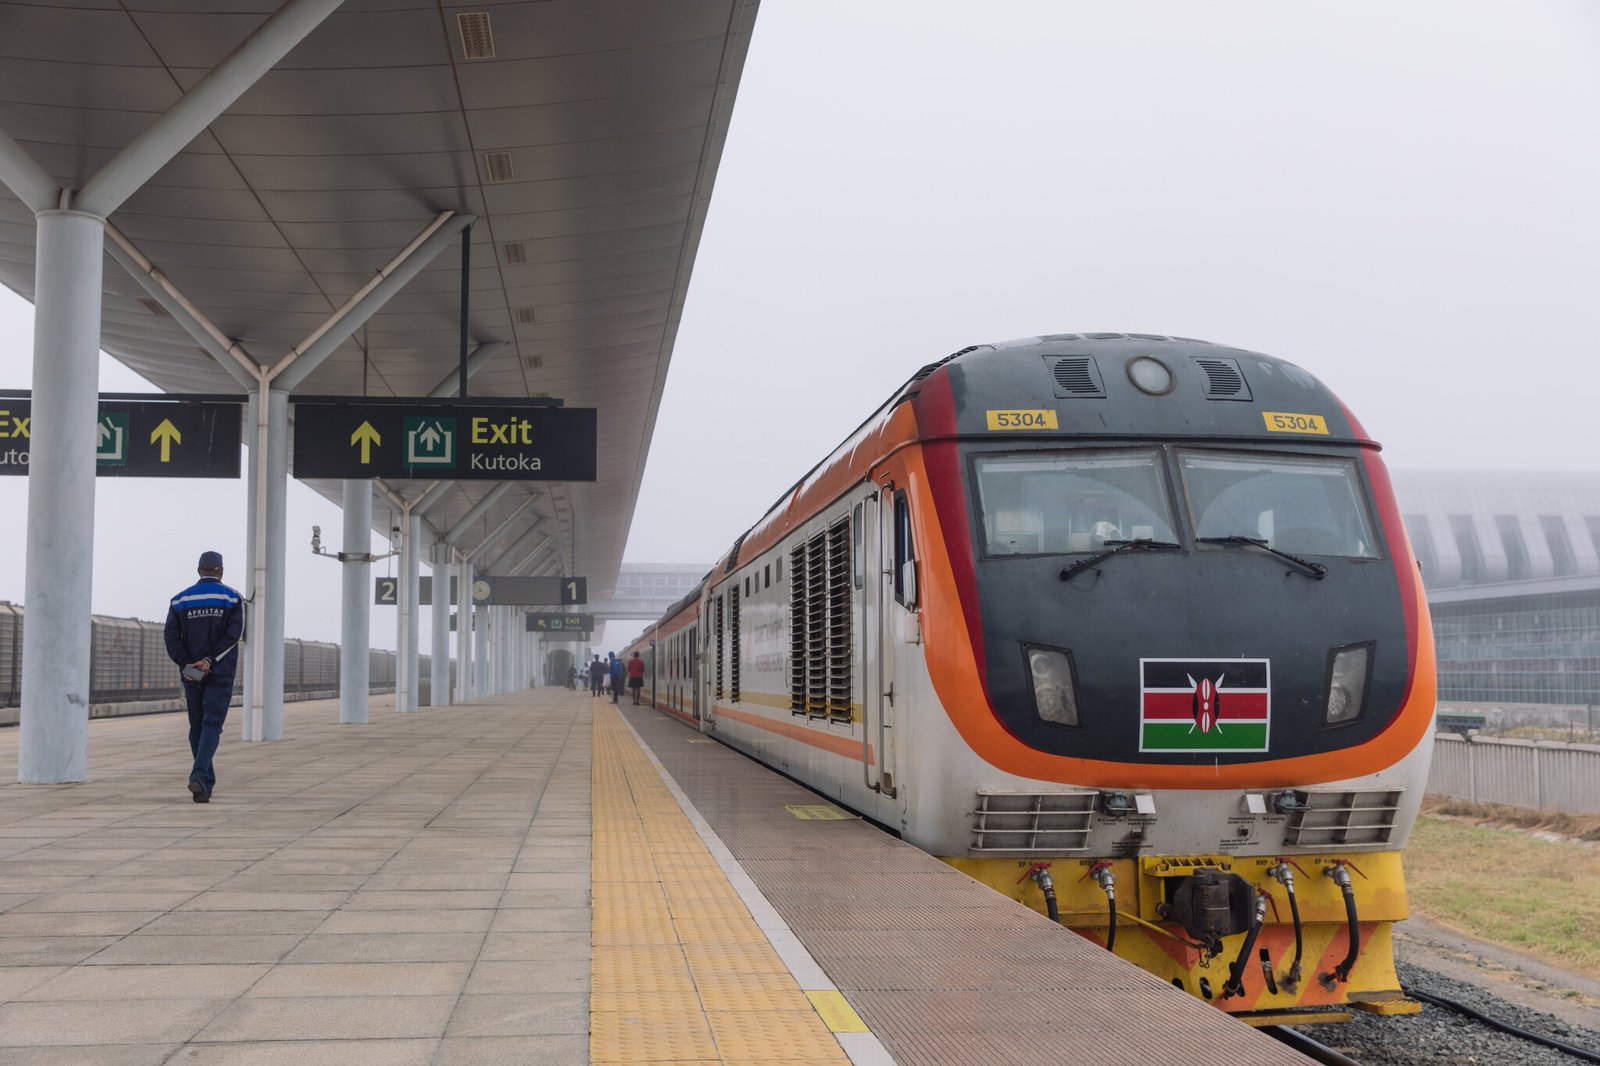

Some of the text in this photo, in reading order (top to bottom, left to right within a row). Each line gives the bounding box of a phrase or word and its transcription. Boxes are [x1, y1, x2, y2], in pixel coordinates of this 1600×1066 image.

[0, 410, 31, 438] Ex
[997, 413, 1047, 428] 5304
[1273, 415, 1320, 432] 5304
[471, 416, 533, 445] Exit
[0, 449, 31, 465] uto
[471, 453, 542, 471] Kutoka
[381, 581, 395, 601] 2
[566, 581, 577, 601] 1
[188, 608, 225, 616] AFRISTAR
[565, 616, 580, 625] Exit
